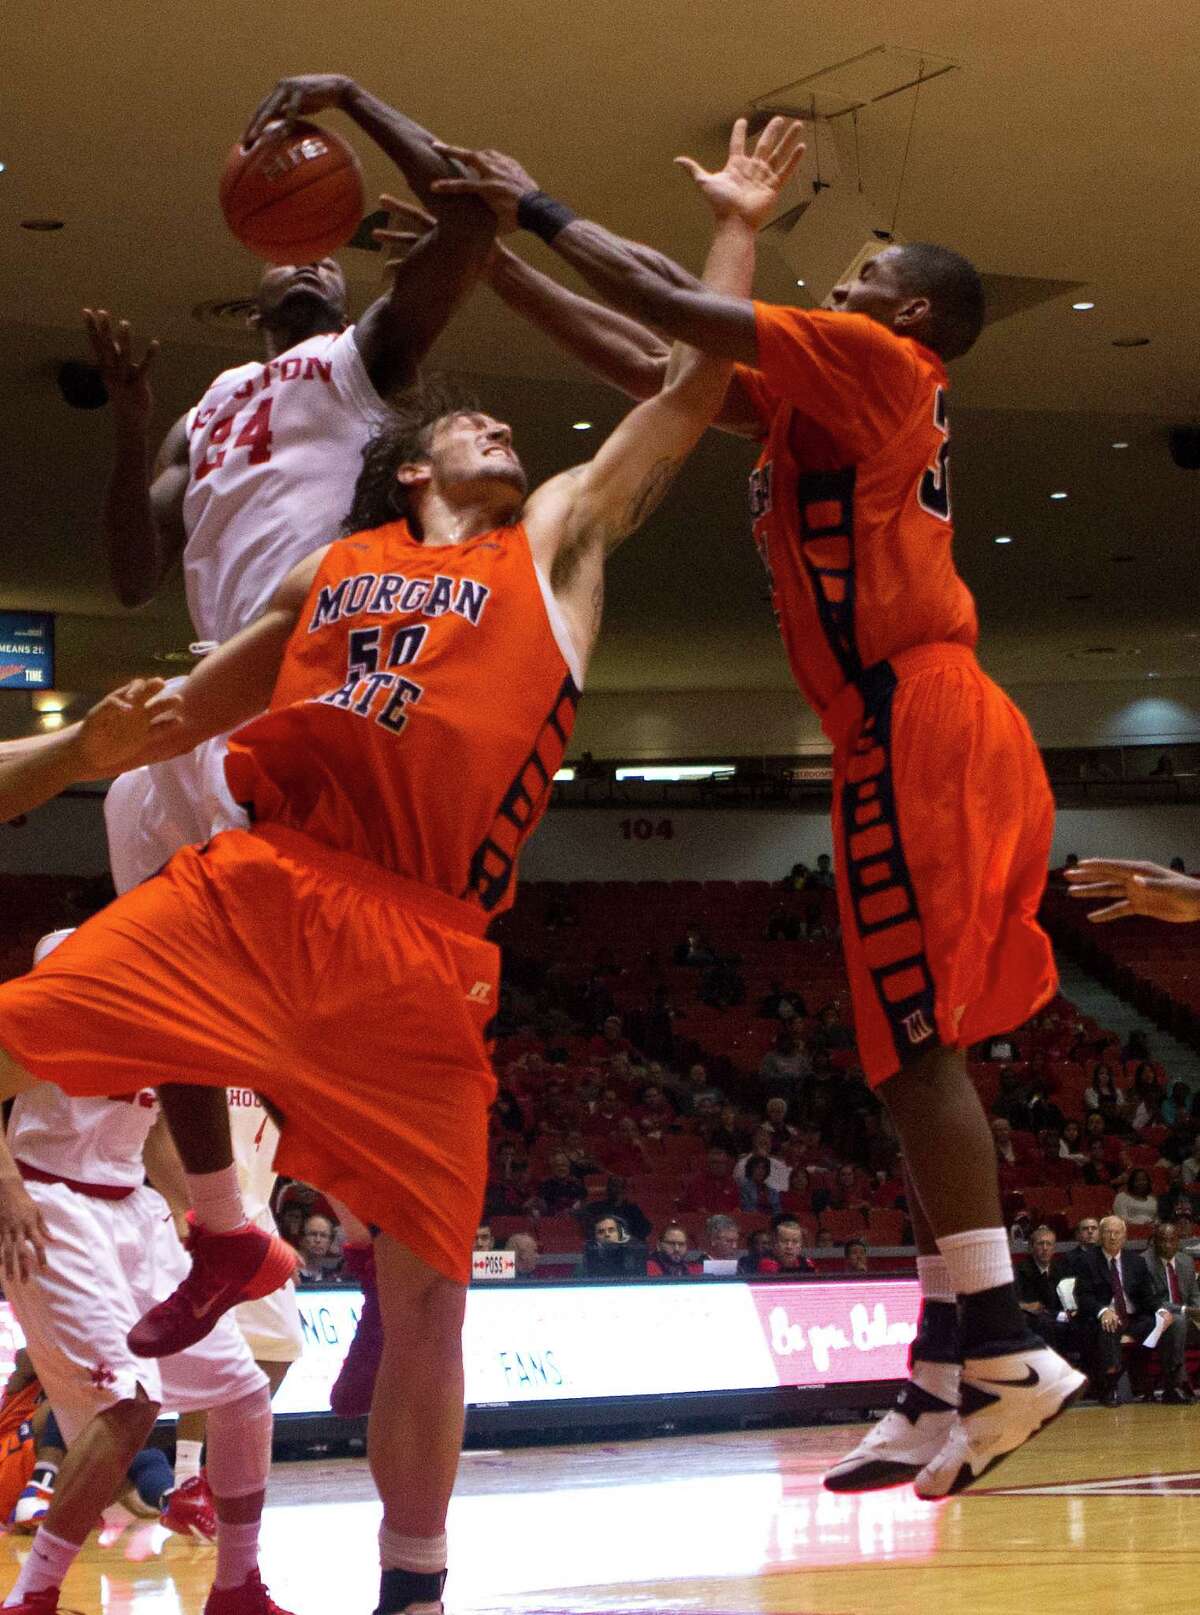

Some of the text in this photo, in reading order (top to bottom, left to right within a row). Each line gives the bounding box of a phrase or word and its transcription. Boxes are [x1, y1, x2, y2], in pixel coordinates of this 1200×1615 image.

[195, 397, 274, 481] 24
[308, 572, 491, 634] MORGAN
[25, 669, 43, 682] TIME
[348, 624, 429, 677] 50
[308, 671, 423, 735] ATE
[619, 818, 674, 840] 104
[485, 1256, 504, 1274] POSS
